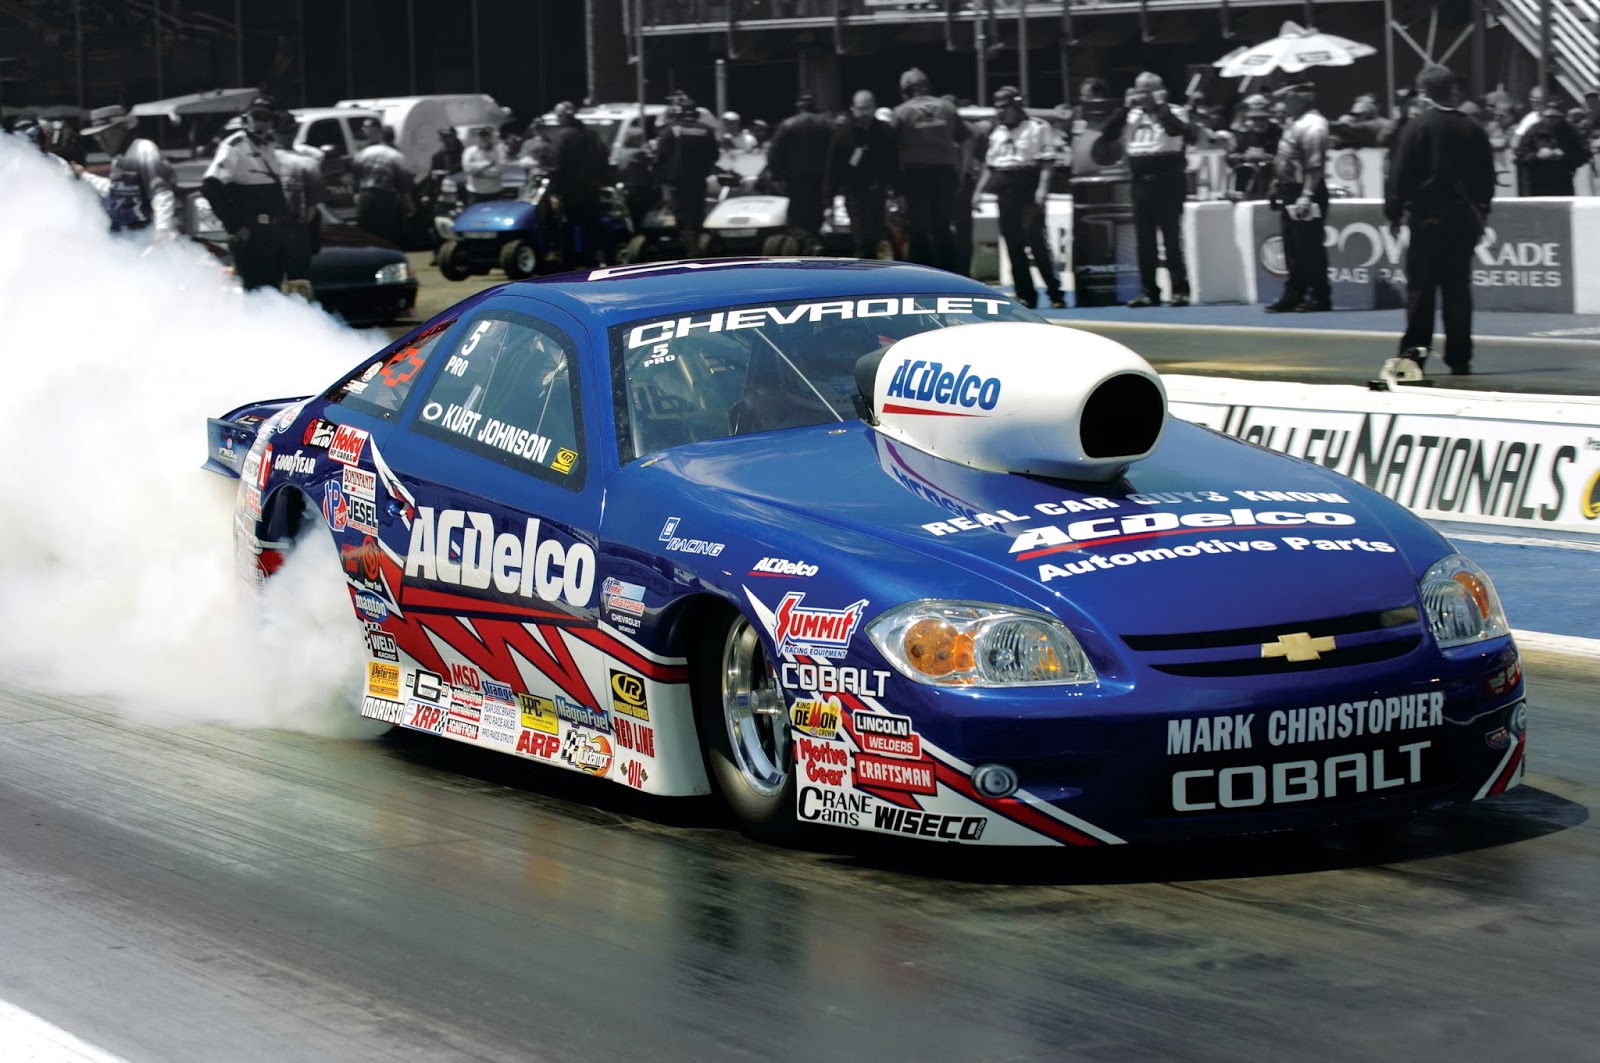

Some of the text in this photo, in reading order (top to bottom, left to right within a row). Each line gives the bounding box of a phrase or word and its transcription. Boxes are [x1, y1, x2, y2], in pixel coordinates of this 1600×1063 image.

[1327, 267, 1369, 283] RAG
[1472, 270, 1561, 287] SERIES
[628, 297, 1010, 349] CHEVROLET
[461, 320, 491, 356] 5
[651, 343, 669, 358] 5
[444, 355, 469, 377] PRO
[644, 354, 676, 367] PRO
[887, 359, 1001, 411] ACDelco
[331, 426, 364, 462] Holley
[441, 403, 552, 464] KURT JOHNSON
[275, 450, 316, 477] GOODYEAR
[348, 500, 378, 528] JESEL
[921, 490, 1350, 536] REAL CAR GUYS KNOW
[1008, 508, 1356, 553] ACDelco
[404, 506, 596, 607] ACDelco
[666, 538, 725, 556] RACING
[1039, 536, 1396, 582] Automotive Parts
[753, 557, 819, 577] ACDelco
[355, 594, 387, 616] manton
[611, 613, 641, 628] CHEVROLET
[371, 633, 396, 653] WELD
[785, 645, 847, 659] RACING EQUIPMENT
[452, 663, 480, 691] MSD
[482, 680, 513, 700] Strange
[782, 663, 891, 698] COBALT
[361, 698, 404, 725] MOROSO
[410, 703, 441, 729] XRP
[556, 698, 609, 730] MagnaFuel
[794, 702, 837, 729] DEMON
[796, 701, 810, 710] KING
[448, 719, 478, 739] IGNITION
[856, 716, 908, 735] LINCOLN
[1167, 692, 1444, 755] MARK CHRISTOPHER
[516, 730, 560, 758] ARP
[614, 717, 655, 758] RED LINE
[869, 736, 913, 753] WELDERS
[800, 738, 848, 767] Motive
[628, 759, 642, 789] OIL
[806, 759, 843, 786] Gear
[860, 760, 931, 787] CRAFTSMAN
[1172, 740, 1432, 812] COBALT
[875, 806, 985, 840] WISECO
